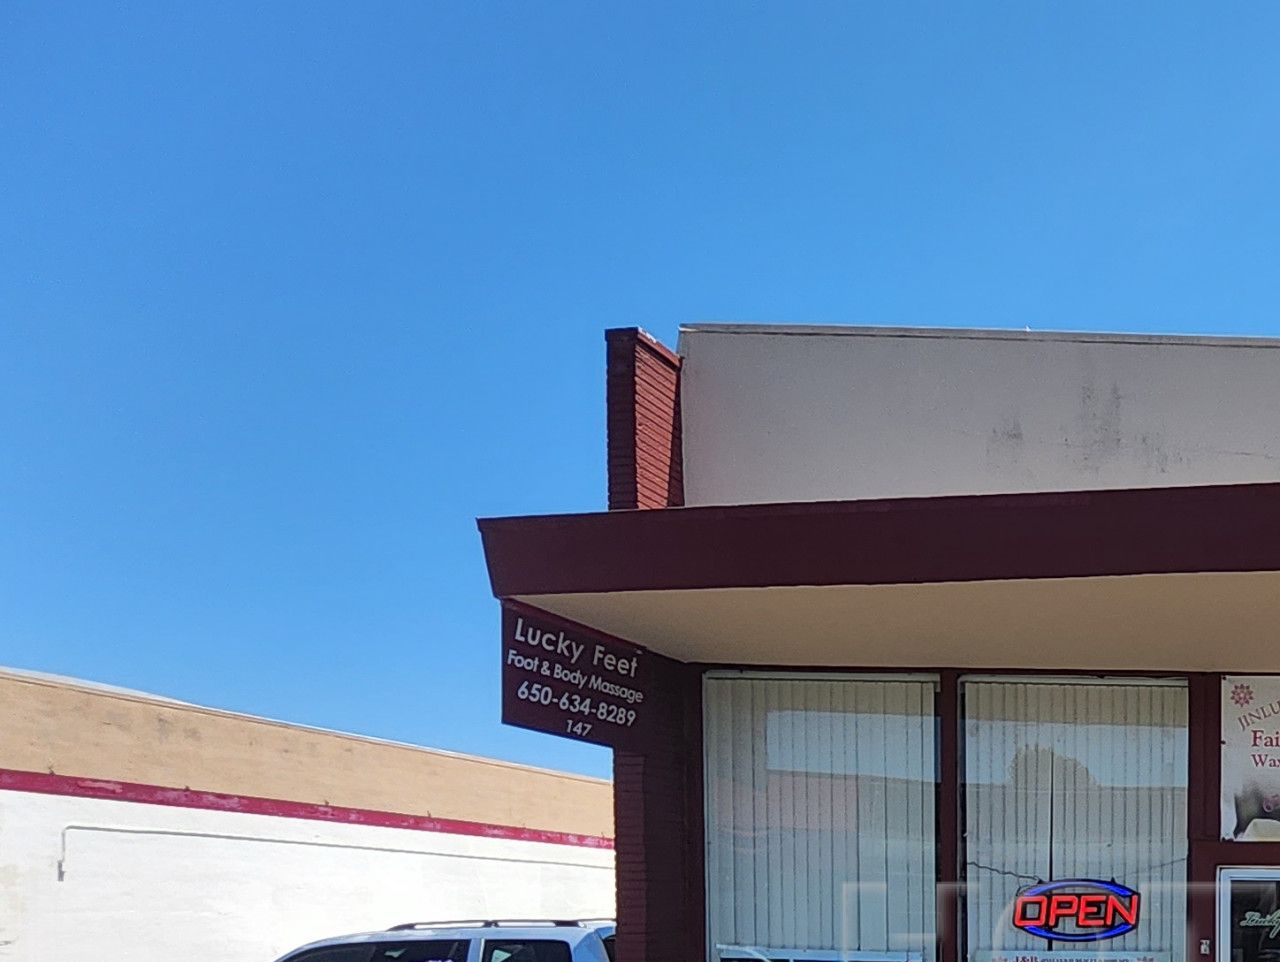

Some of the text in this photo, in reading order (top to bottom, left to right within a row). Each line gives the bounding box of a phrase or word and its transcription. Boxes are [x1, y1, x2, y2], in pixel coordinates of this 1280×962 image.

[514, 618, 638, 677] Lucky Feet
[507, 649, 644, 703] Foot & Body Massage
[517, 681, 636, 727] 650-634-8289
[566, 719, 592, 736] 147
[1014, 894, 1138, 926] OPEN
